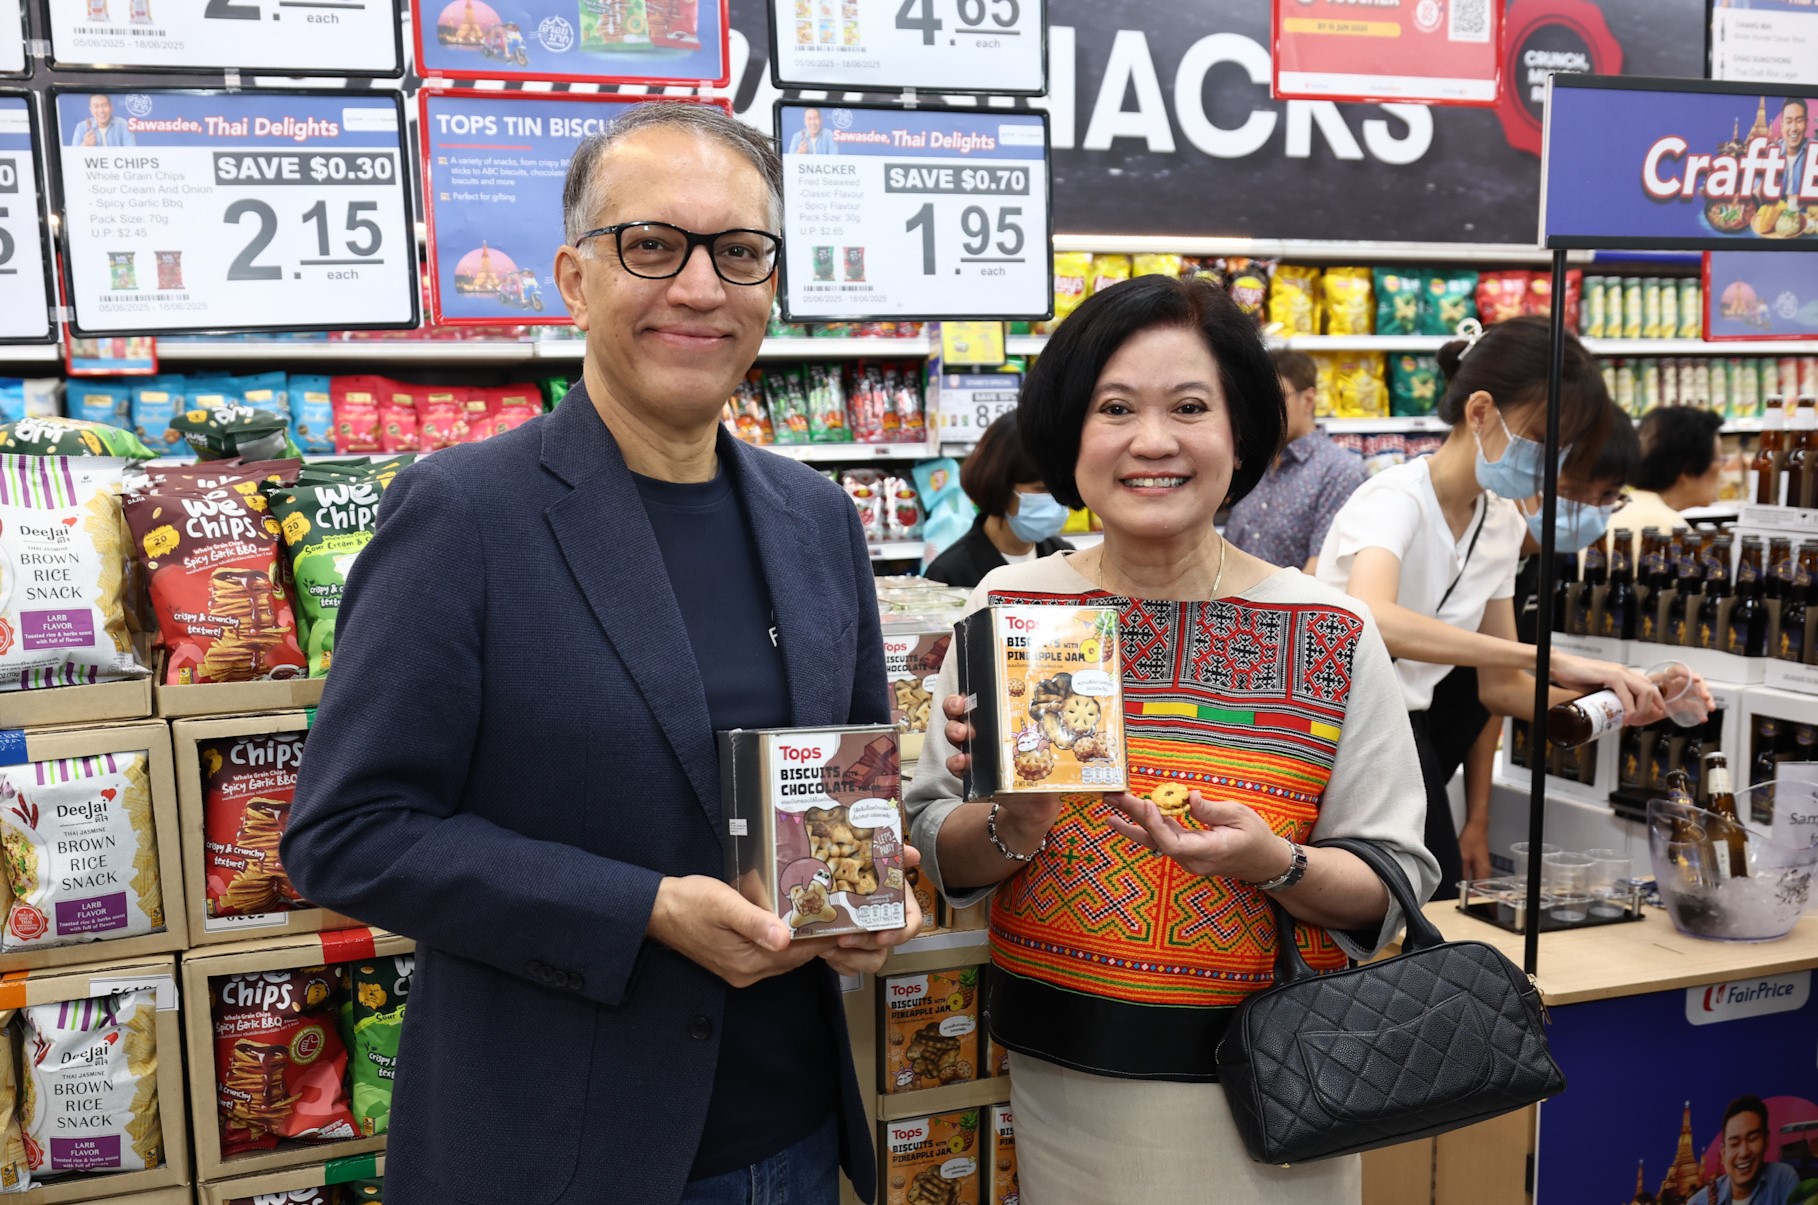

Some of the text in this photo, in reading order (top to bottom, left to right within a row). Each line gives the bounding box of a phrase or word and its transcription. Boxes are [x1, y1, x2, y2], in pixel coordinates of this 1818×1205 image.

[306, 13, 339, 24] each
[975, 39, 1000, 48] each
[1048, 26, 1433, 165] ACKS
[127, 116, 339, 141] Sawasdee, Thai Delights
[435, 114, 499, 136] TOPS
[503, 116, 543, 137] TIN
[832, 129, 996, 152] Sawasdee, Thai Delights
[84, 158, 160, 169] WE CHIPS
[217, 156, 392, 182] SAVE $0.30
[798, 164, 856, 175] SNACKER
[1642, 136, 1786, 199] Craft
[86, 171, 185, 182] Whole Grain Chips
[451, 177, 480, 185] biscuits
[481, 178, 495, 186] and
[889, 167, 1026, 191] SAVE $0.70
[120, 184, 155, 194] Cream
[158, 184, 178, 194] And
[182, 184, 213, 194] Onion
[453, 192, 478, 201] Perfect
[479, 192, 490, 201] for
[96, 198, 184, 210] Spicy Garlic Bbq
[90, 214, 117, 224] Pack
[149, 214, 169, 226] 70g
[327, 269, 359, 280] each
[981, 266, 1006, 276] each
[20, 553, 80, 565] BROWN
[183, 554, 209, 569] Spicy
[210, 549, 236, 562] Garlic
[237, 544, 258, 555] BBQ
[34, 569, 72, 581] RICE
[26, 586, 83, 600] SNACK
[47, 614, 68, 622] LARB
[207, 614, 240, 627] crunchy
[886, 655, 918, 663] ISCUITS
[1064, 652, 1086, 662] JAM
[887, 664, 929, 673] HOCOLATE
[779, 746, 822, 763] Tops
[233, 773, 253, 781] Whole
[780, 766, 841, 780] BISCUITS
[222, 782, 247, 795] Spicy
[249, 778, 275, 790] Garlic
[781, 781, 855, 796] CHOCOLATE
[57, 799, 108, 820] DeeJai
[57, 835, 116, 854] BROWN
[233, 847, 265, 860] crunchy
[70, 855, 108, 871] RICE
[62, 870, 118, 891] SNACK
[82, 901, 102, 910] LARB
[77, 909, 107, 918] FLAVOR
[891, 985, 922, 997] Tops
[1727, 982, 1795, 1004] FairPrice
[891, 996, 933, 1009] BISCUITS
[935, 1005, 952, 1013] JAM
[216, 1022, 235, 1033] Spicy
[237, 1020, 260, 1031] Garlic
[261, 1017, 282, 1028] BBQ
[54, 1080, 114, 1096] BROWN
[66, 1098, 103, 1112] RICE
[57, 1114, 112, 1129] SNACK
[892, 1128, 922, 1140] Tops
[892, 1140, 934, 1153] BISCUITS
[936, 1147, 952, 1156] JAM
